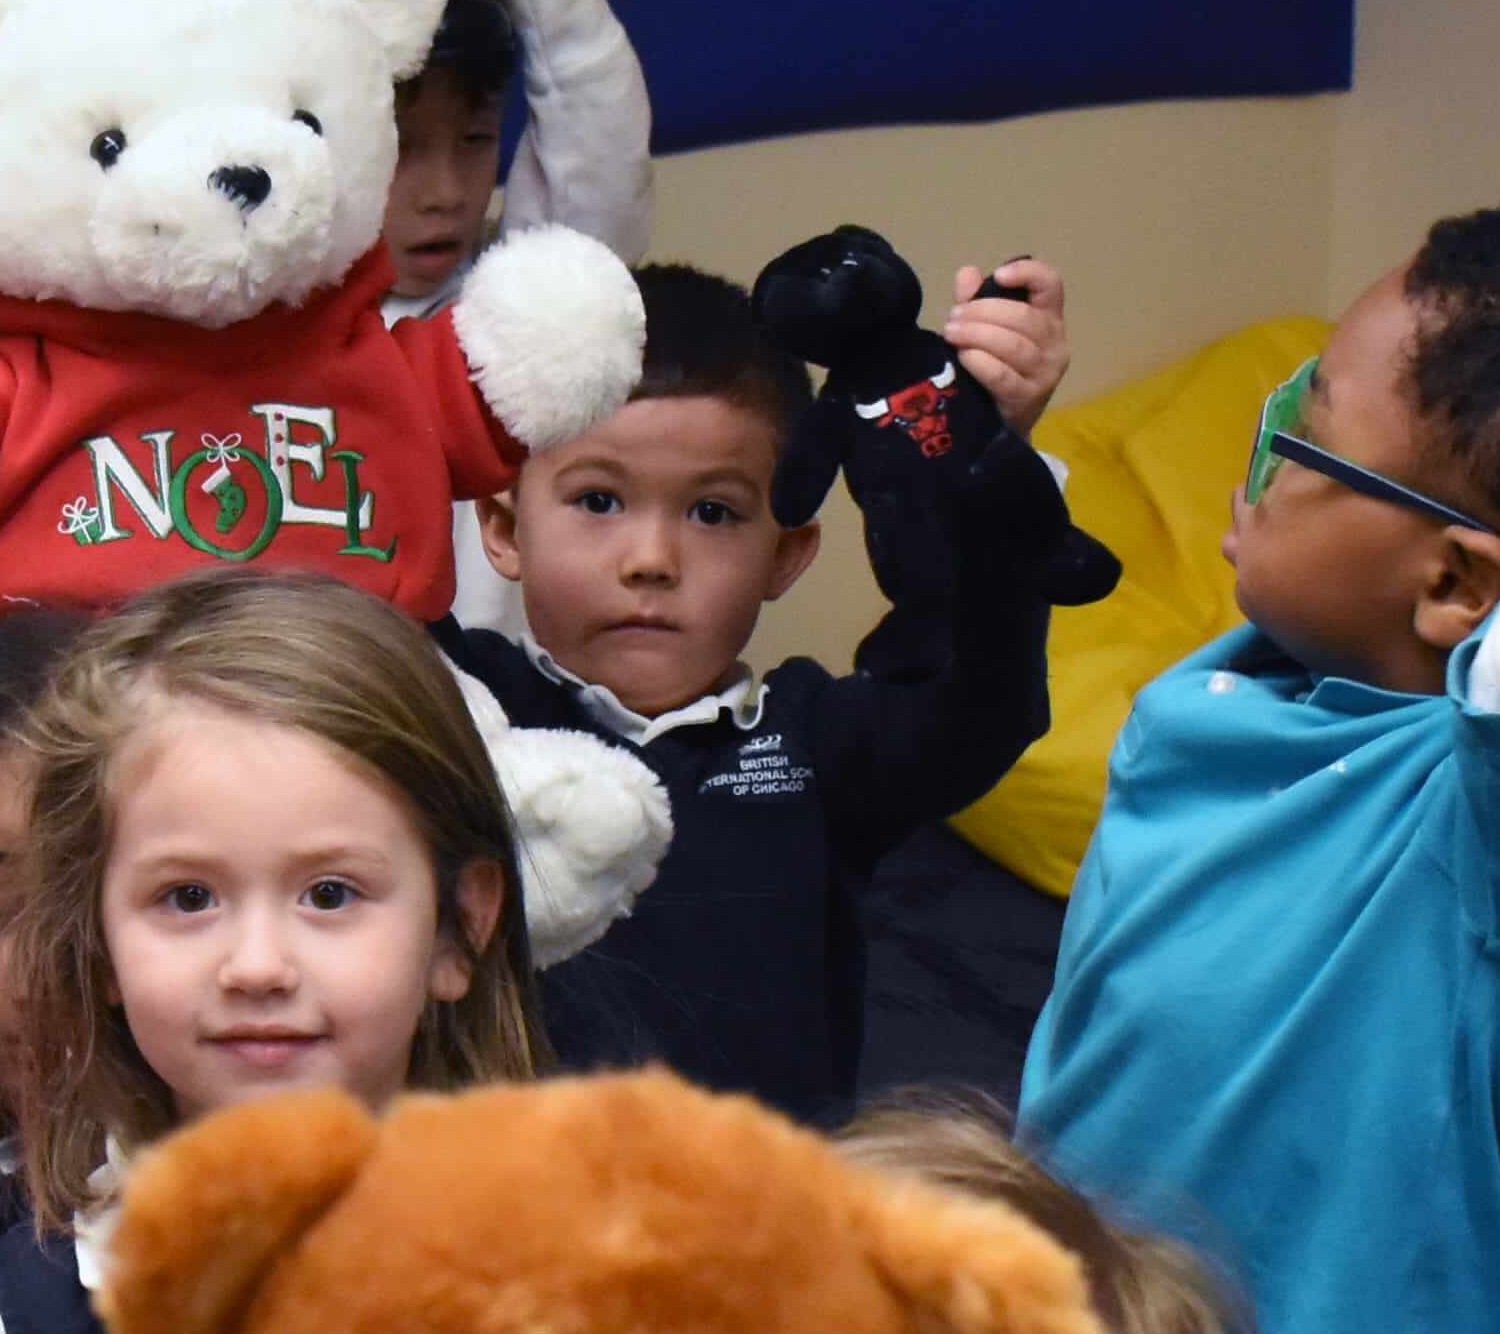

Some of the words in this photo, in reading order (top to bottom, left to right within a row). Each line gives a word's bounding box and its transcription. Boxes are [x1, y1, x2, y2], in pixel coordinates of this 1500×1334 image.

[83, 402, 398, 563] NOEL
[740, 755, 789, 771] BRITISH
[732, 784, 750, 796] OF
[751, 780, 805, 795] CHICAGO
